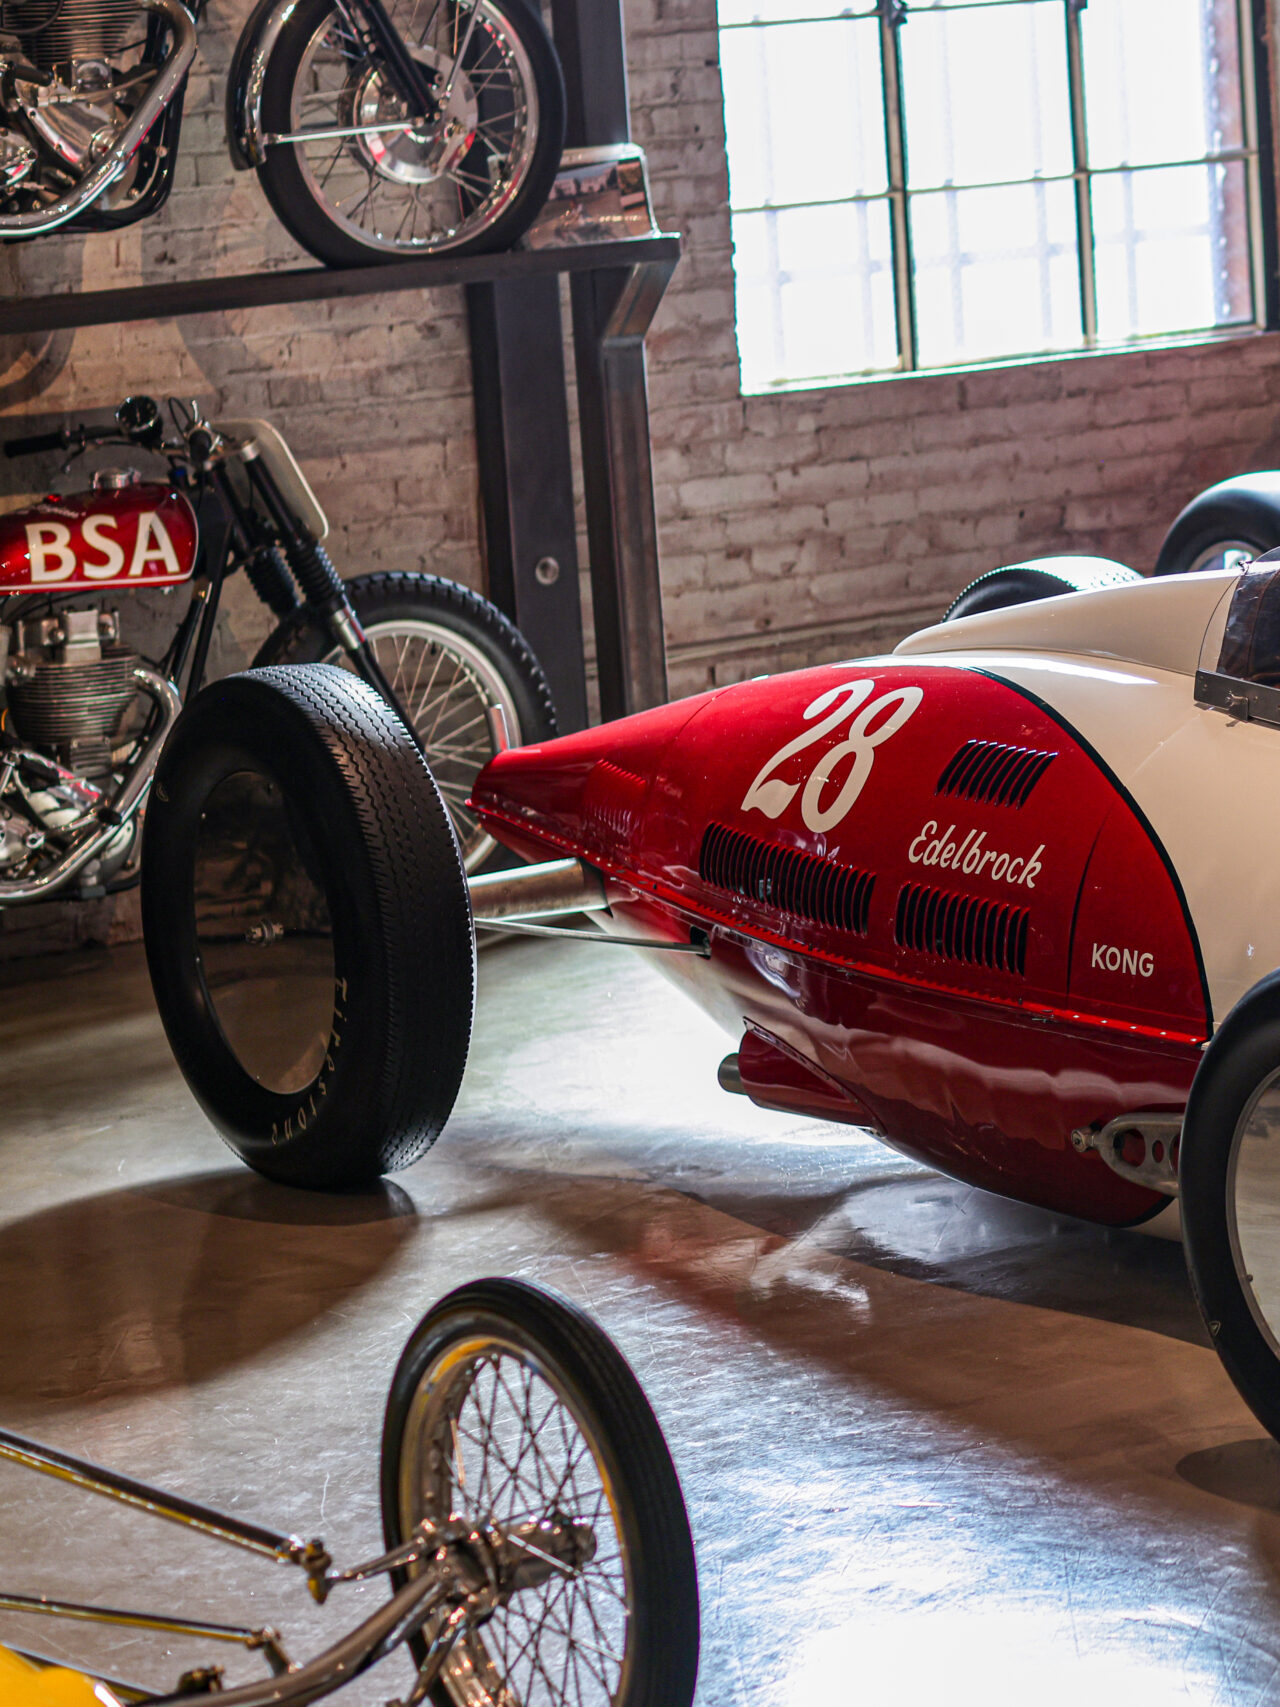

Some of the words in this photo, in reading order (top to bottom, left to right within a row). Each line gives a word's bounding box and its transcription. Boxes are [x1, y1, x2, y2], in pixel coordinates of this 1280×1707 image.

[25, 511, 180, 583] BSA
[740, 679, 924, 833] 28
[908, 820, 1046, 889] Edelbrock
[1091, 943, 1155, 977] KONG
